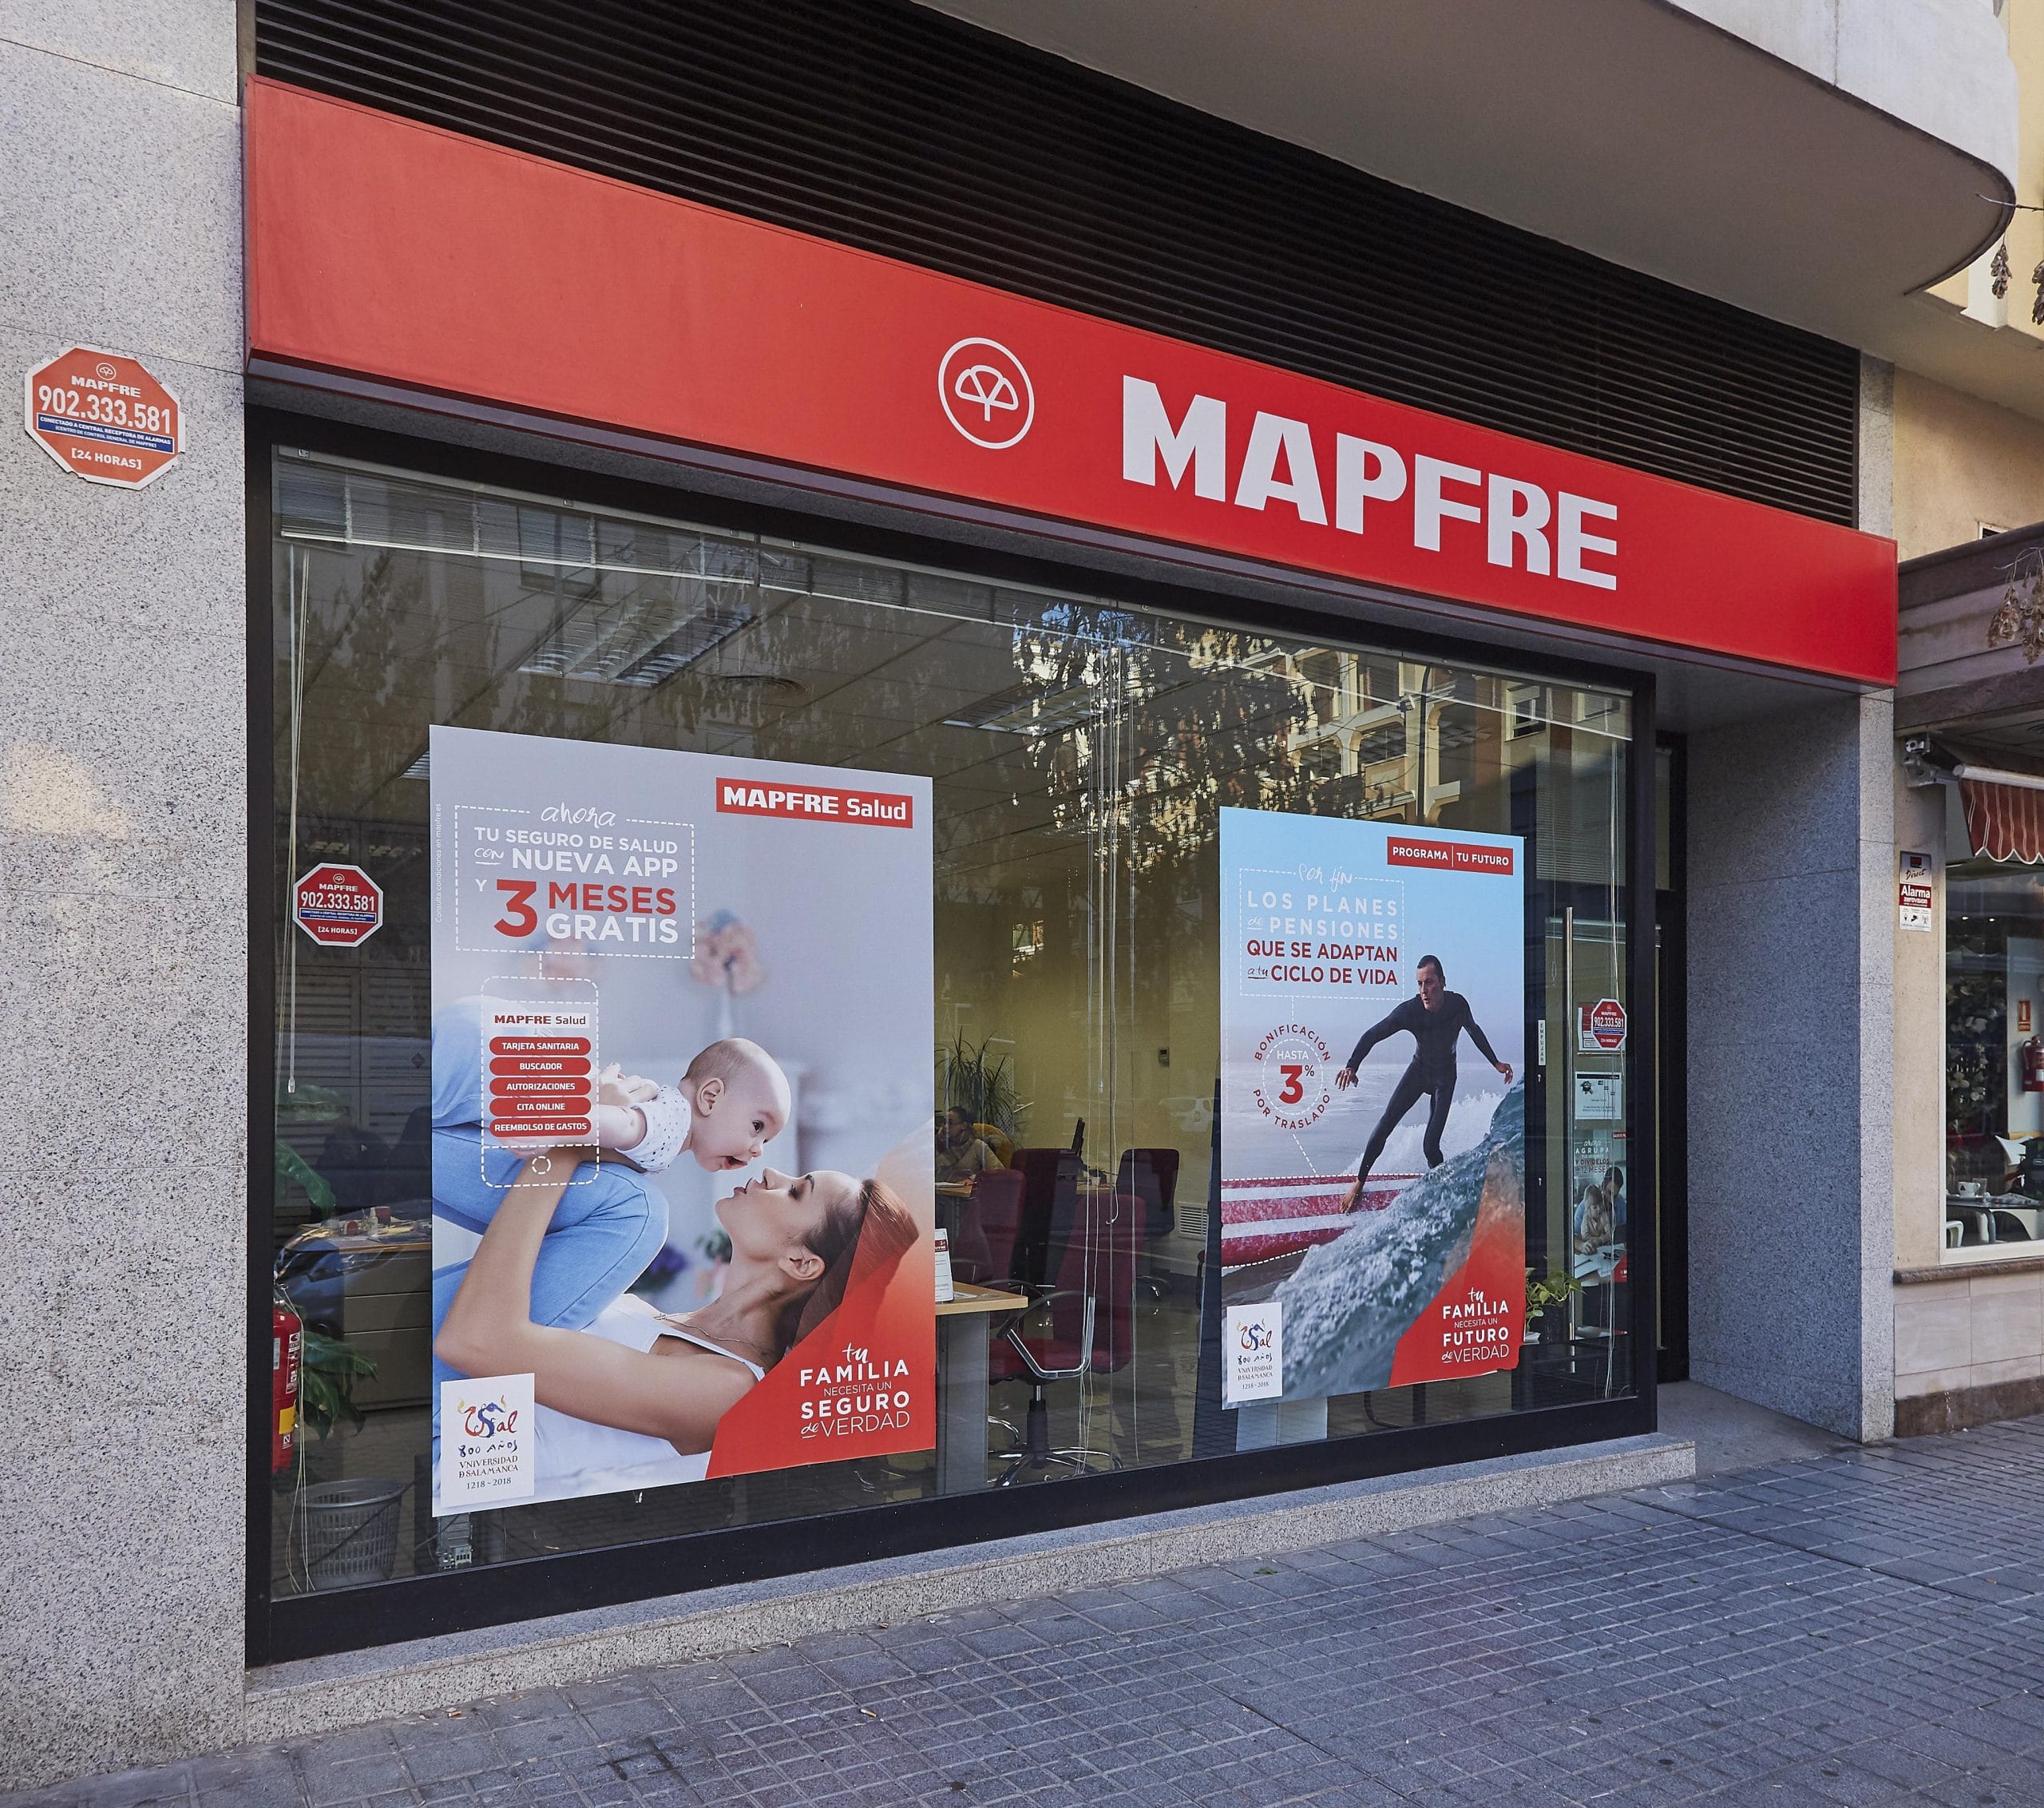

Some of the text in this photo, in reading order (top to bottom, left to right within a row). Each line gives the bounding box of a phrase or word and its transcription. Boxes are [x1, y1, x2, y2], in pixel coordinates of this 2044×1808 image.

[71, 375, 141, 398] MAPFRE
[38, 385, 171, 434] 902.333.581
[40, 416, 73, 427] CONECTADO
[79, 423, 105, 433] CENTRAL
[105, 427, 137, 438] RECEPTORA
[145, 435, 172, 445] ALARMAS
[71, 447, 142, 470] [24 HORAS]
[1123, 375, 1618, 591] MAPFRE
[723, 786, 906, 820] MAPFRE Salud
[541, 802, 617, 829] ahora
[474, 827, 678, 854] TU SEGURO DE SALUD
[512, 848, 615, 875] NUEVA
[622, 853, 678, 878] APP
[1392, 847, 1509, 866] PROGRAMA TU FUTURO
[319, 883, 358, 892] MAPFRE
[1901, 885, 1931, 898] Alarma
[301, 891, 374, 911] 902.333.581
[474, 878, 676, 938] Y 3 MESES
[1247, 890, 1397, 917] LOS PLANES
[331, 926, 358, 935] HORAS]
[545, 913, 679, 944] GRATIS
[1247, 916, 1398, 940] de PENSIONES
[1246, 939, 1398, 963] QUE SE ADAPTAN
[1270, 965, 1324, 983] CICLO
[1330, 967, 1352, 984] DE
[1357, 968, 1398, 985] VIDA
[494, 1015, 586, 1025] MAPFRE Salud
[1594, 1017, 1624, 1029] 902.333.581
[501, 1042, 536, 1051] TARJETA
[1254, 1024, 1331, 1061] BONIFICACIÓN
[1277, 1050, 1309, 1060] HASTA
[1253, 1088, 1271, 1117] POR
[494, 1123, 544, 1132] REEMBOLSO
[1468, 1287, 1484, 1303] tu
[1443, 1300, 1509, 1319] FAMILIA
[1454, 1318, 1487, 1329] NECESITA
[1443, 1326, 1509, 1347] FUTURO
[842, 1342, 869, 1364] tu
[1238, 1355, 1251, 1365] 800
[1453, 1344, 1510, 1363] VERDAD
[800, 1359, 909, 1386] FAMILIA
[823, 1381, 892, 1397] NECESITA UN
[801, 1390, 909, 1420] SEGURO
[801, 1410, 910, 1437] de VERDAD
[458, 1445, 481, 1458] 800
[466, 1481, 485, 1489] 1218
[493, 1477, 512, 1486] 2018
